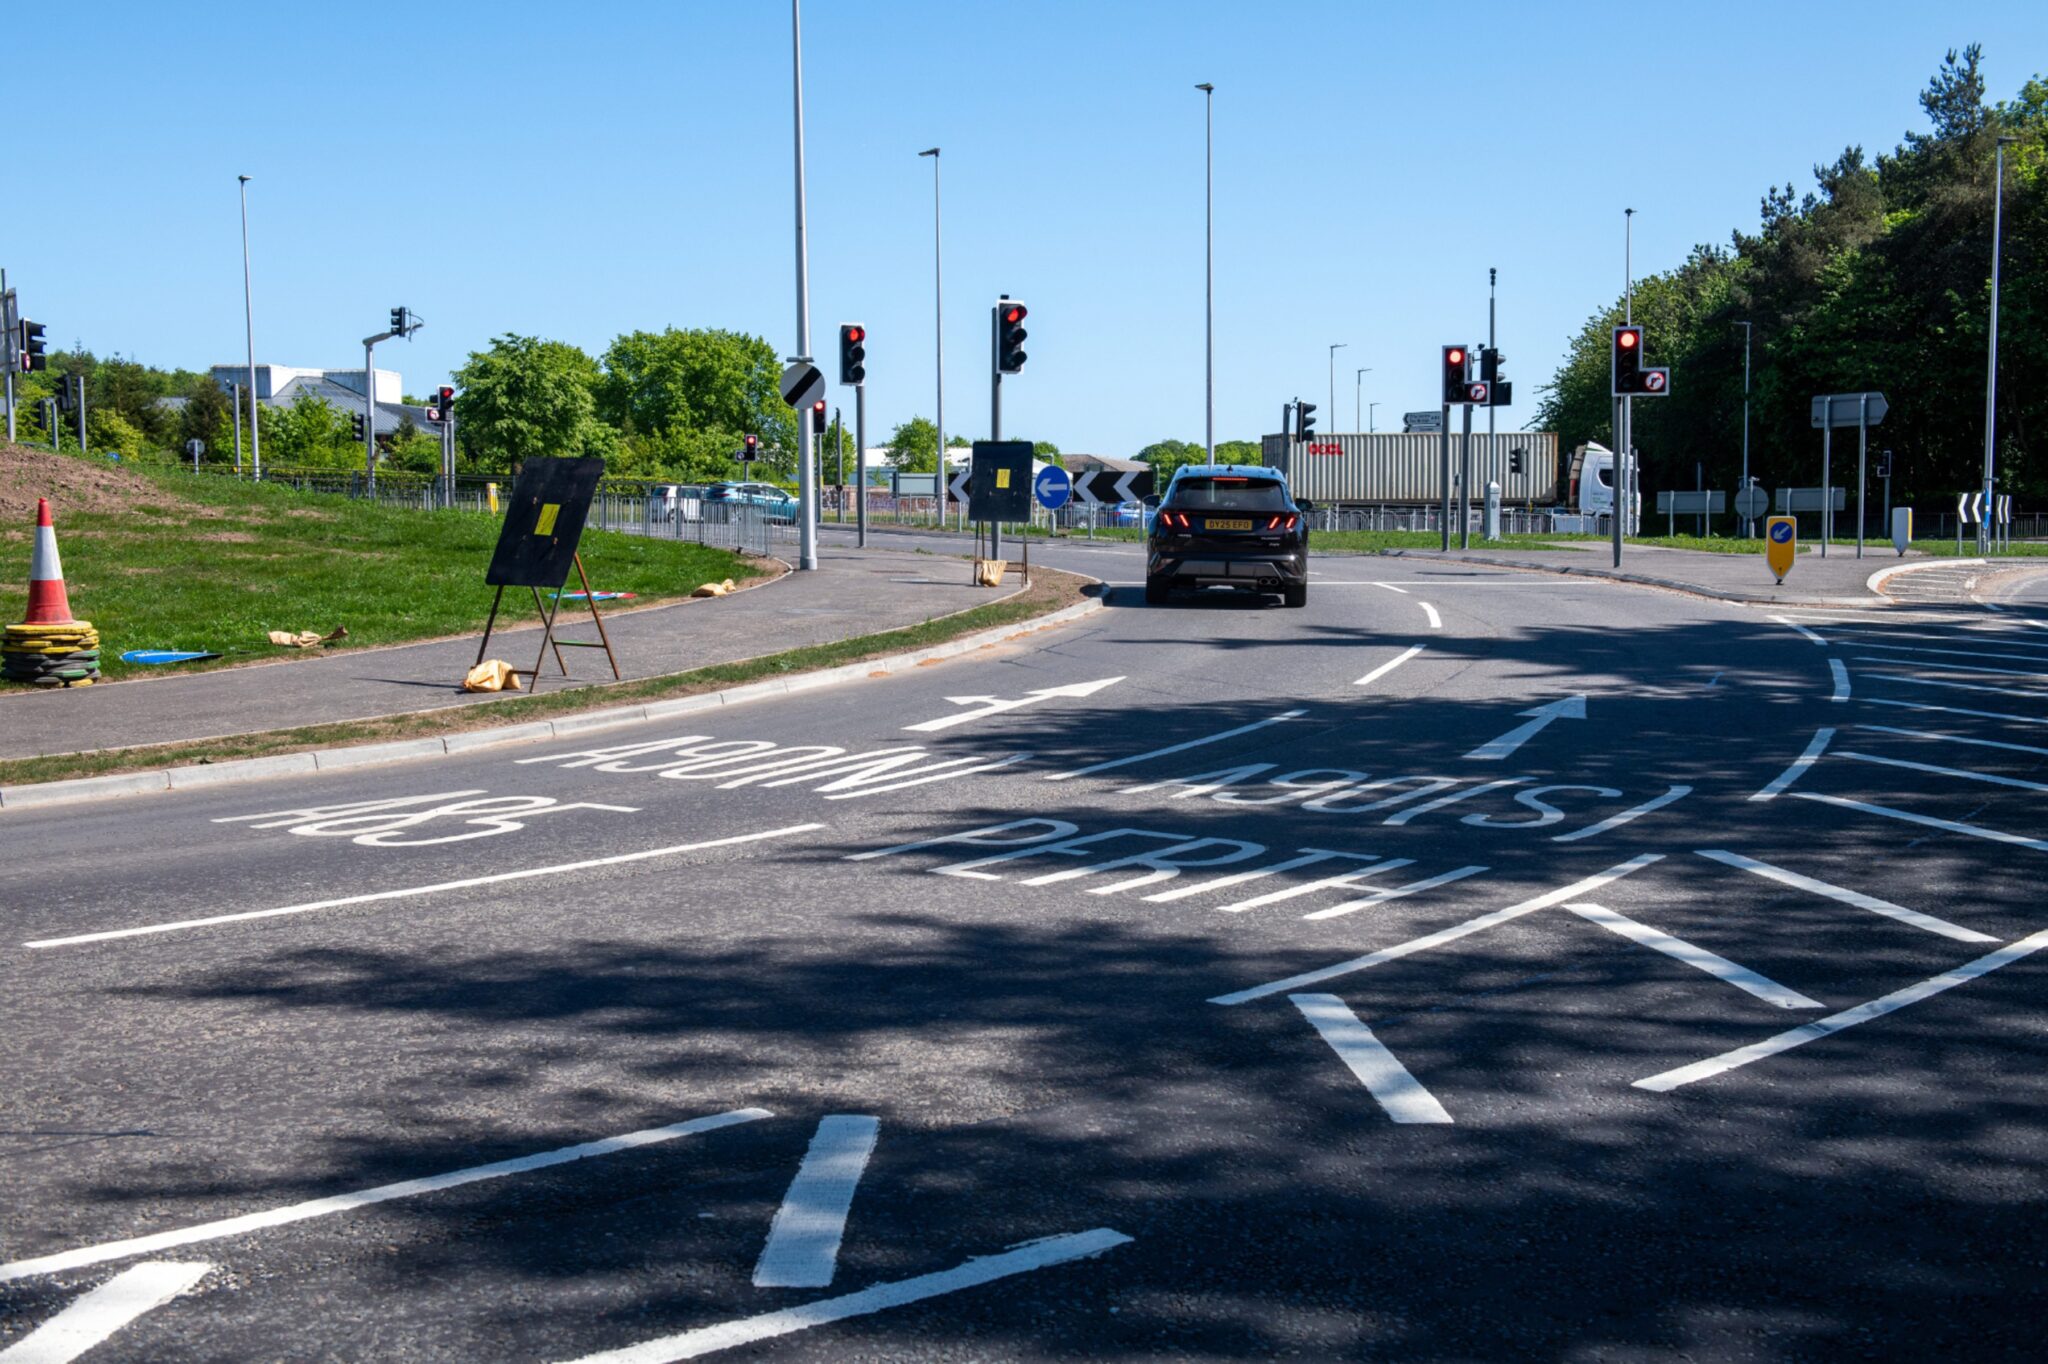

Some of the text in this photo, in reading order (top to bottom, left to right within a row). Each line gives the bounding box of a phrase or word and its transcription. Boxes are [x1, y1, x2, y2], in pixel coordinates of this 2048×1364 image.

[1309, 442, 1344, 456] OOCL
[1209, 520, 1231, 529] DY25
[513, 735, 1034, 800] A90(N)
[210, 789, 642, 847] A85
[1116, 763, 1693, 842] A90(S)
[842, 818, 1491, 920] PERTH
